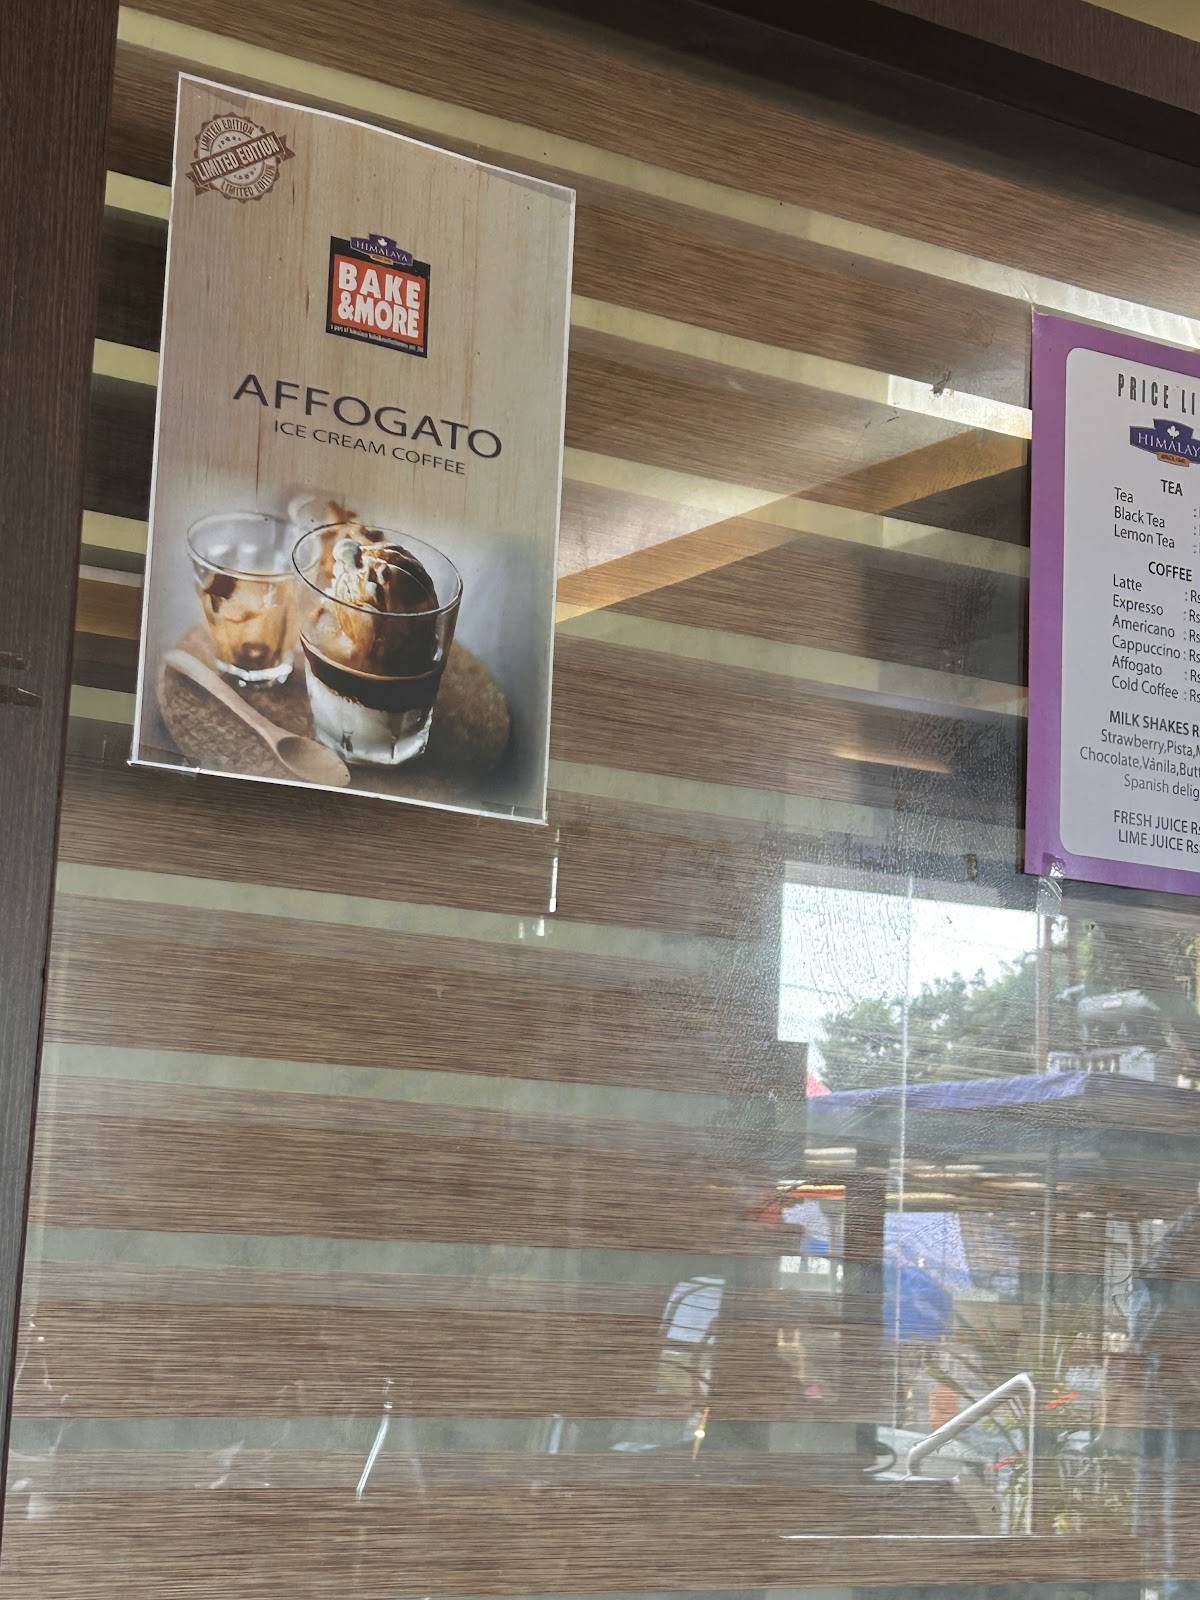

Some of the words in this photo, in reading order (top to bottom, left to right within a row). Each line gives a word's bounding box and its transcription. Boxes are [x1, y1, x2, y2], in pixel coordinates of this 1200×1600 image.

[195, 151, 240, 181] LIMITED
[236, 135, 280, 165] EDITION
[356, 240, 408, 262] HIMALAYA
[338, 261, 421, 310] BAKE
[337, 291, 420, 338] &MORE
[1117, 373, 1169, 409] PRICE
[233, 374, 502, 459] AFFOGATO
[274, 420, 307, 439] ICE
[313, 429, 386, 457] CREAM
[391, 447, 465, 475] COFFEE
[1114, 486, 1134, 503] Tea
[1160, 479, 1183, 496] TEA
[1114, 505, 1145, 524] Black
[1146, 512, 1165, 528] Tea
[1114, 523, 1154, 544] Lemon
[1155, 532, 1175, 549] Tea
[1113, 573, 1143, 592] Latte
[1148, 561, 1193, 583] COFFEE
[1113, 594, 1164, 616] Expresso
[1112, 614, 1176, 638] Americano
[1112, 635, 1181, 660] Cappuccino
[1112, 655, 1163, 677] Affogato
[1111, 675, 1139, 692] Cold
[1141, 680, 1179, 699] Coffee
[1109, 710, 1141, 728] MILK
[1142, 715, 1189, 735] SHAKES
[1123, 774, 1169, 794] Spanish
[1172, 780, 1200, 801] delig
[1113, 809, 1152, 828] FRESH
[1155, 815, 1188, 833] JUICE
[1118, 828, 1148, 846] LIME
[1150, 833, 1183, 851] JUICE
